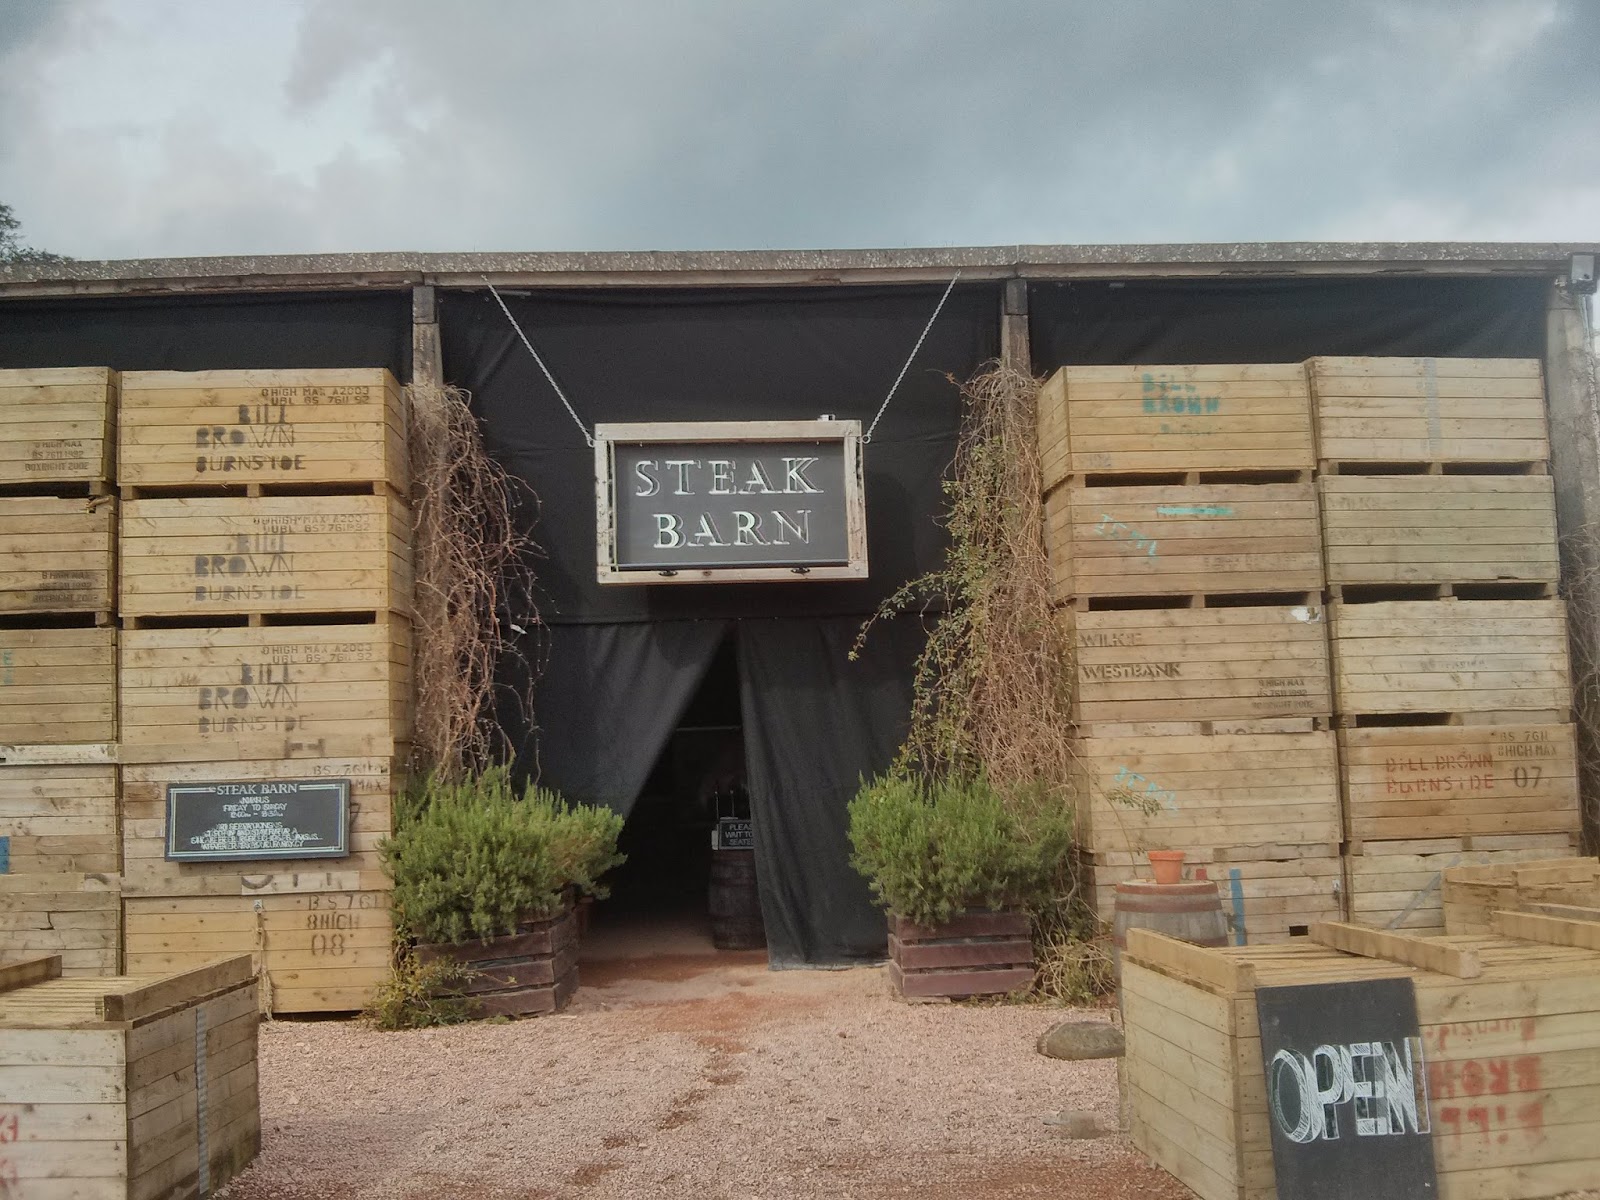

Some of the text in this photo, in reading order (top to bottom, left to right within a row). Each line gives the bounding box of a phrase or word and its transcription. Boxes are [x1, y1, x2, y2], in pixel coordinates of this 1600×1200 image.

[238, 403, 288, 425] BILL
[196, 425, 295, 450] BROWN
[196, 454, 307, 473] BURNSIDE
[635, 456, 825, 497] STEAK
[653, 509, 812, 550] BARN
[195, 554, 294, 578] BROWN
[195, 584, 306, 601] BURNSIDE
[241, 663, 290, 685] BILL
[1081, 662, 1183, 680] WESTBANK
[199, 684, 298, 711] BROWN
[199, 715, 312, 733] BURNSIDE
[1513, 766, 1543, 789] 07
[216, 783, 299, 796] STEAK BARN
[252, 804, 261, 812] TO
[729, 823, 753, 831] PLEAS
[729, 838, 753, 846] SEATE
[311, 933, 345, 957] 08
[1270, 1036, 1432, 1144] OPEN
